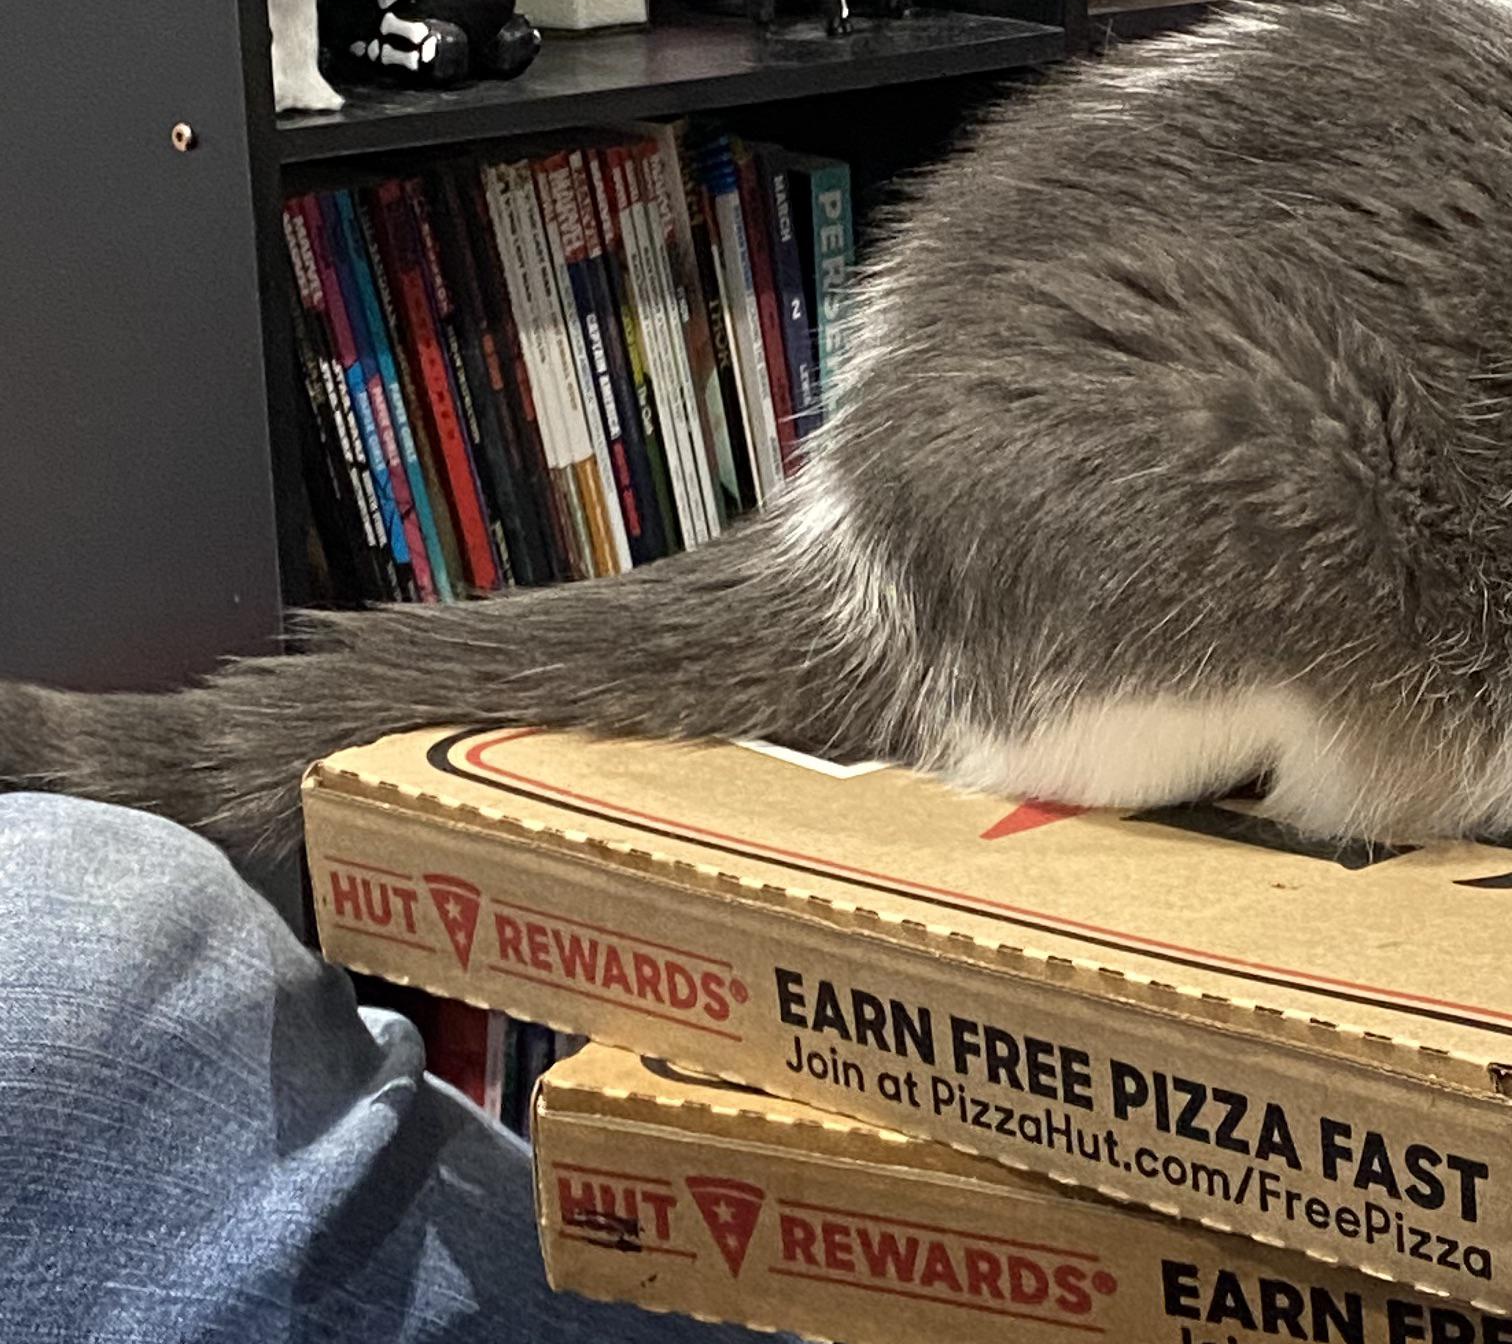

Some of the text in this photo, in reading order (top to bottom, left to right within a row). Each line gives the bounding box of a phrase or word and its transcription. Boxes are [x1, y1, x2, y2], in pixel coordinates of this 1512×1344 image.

[546, 167, 588, 256] MARVEL
[766, 174, 797, 242] MARCH
[787, 295, 804, 321] 2
[583, 313, 621, 437] CAPTAIN AMERICA
[329, 870, 419, 934] HUT
[774, 966, 1489, 1224] EARN FREE PIZZA FAST
[557, 1175, 677, 1242] HUT
[786, 1035, 1494, 1282] Join at PizzaHut.com/FreePizza
